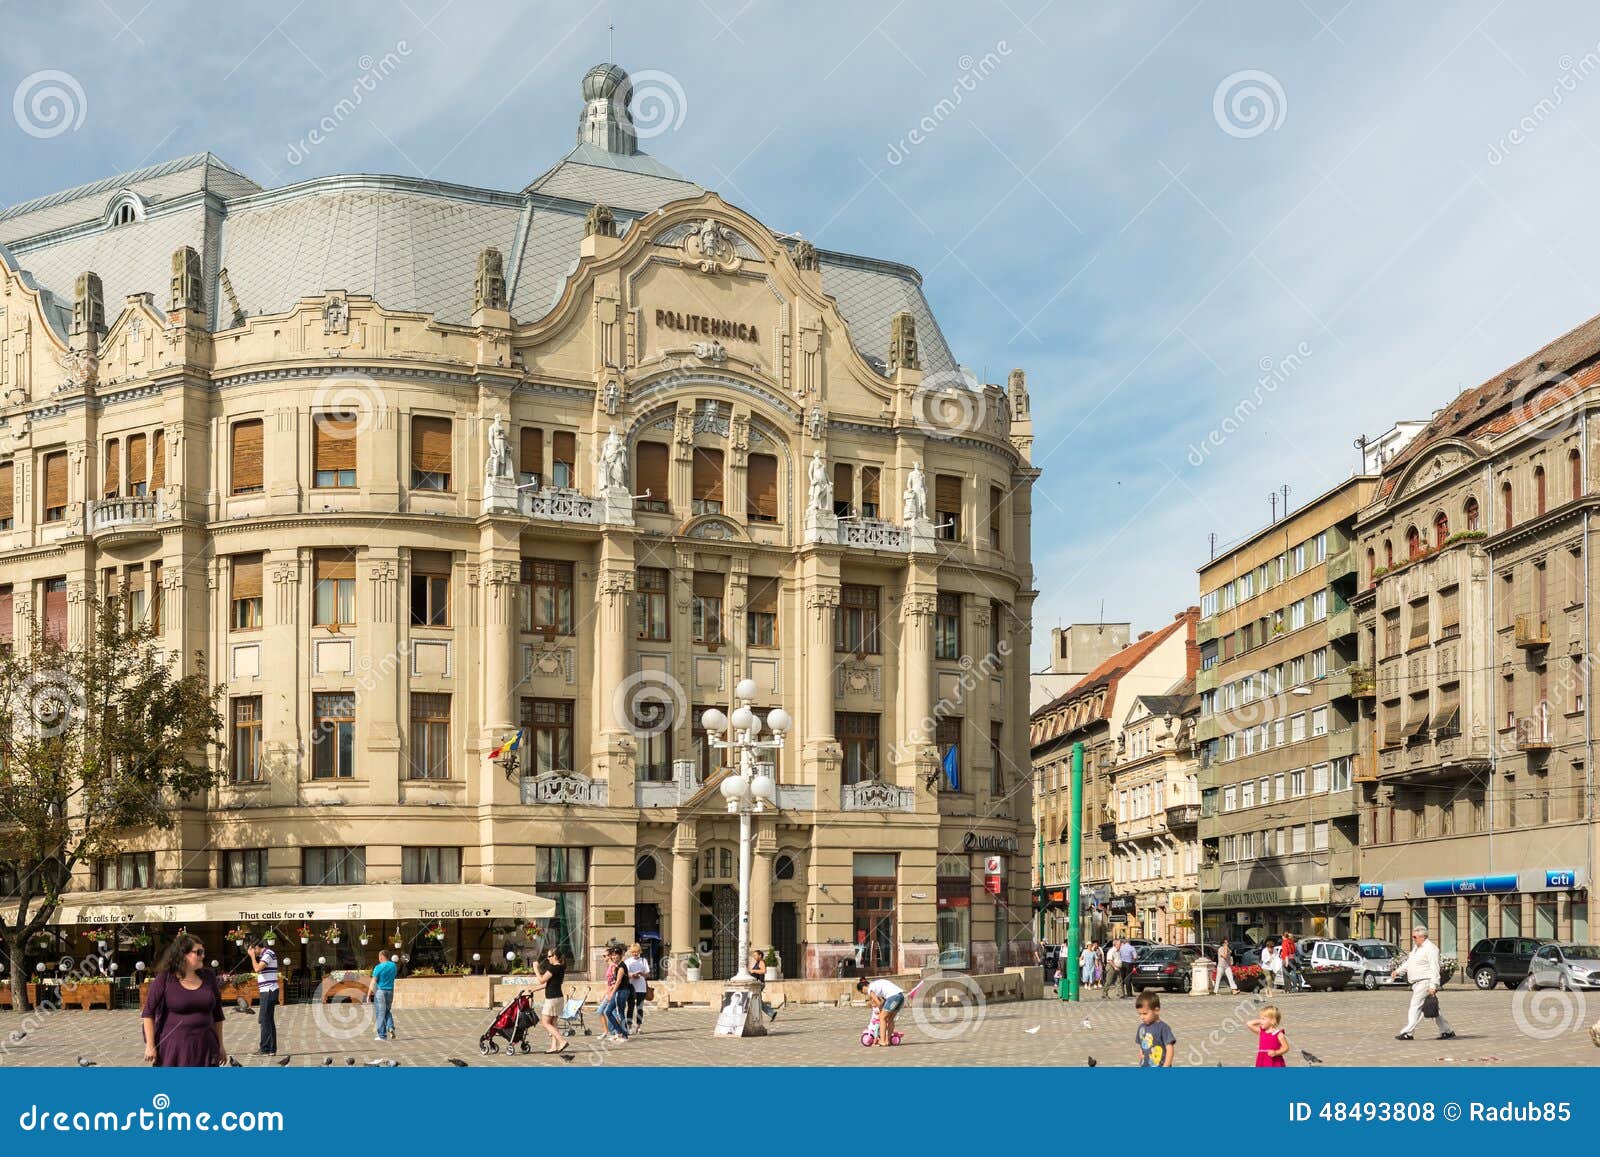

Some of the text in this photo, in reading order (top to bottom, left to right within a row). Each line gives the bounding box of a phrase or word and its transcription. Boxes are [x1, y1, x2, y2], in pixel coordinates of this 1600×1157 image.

[655, 309, 759, 343] POLITEHNICA
[1551, 873, 1569, 885] citi
[1364, 886, 1379, 896] citi
[111, 914, 119, 922] for
[239, 911, 259, 919] That
[262, 911, 281, 919] calls
[284, 911, 295, 919] for
[419, 909, 438, 918] That
[441, 909, 459, 917] calls
[462, 909, 473, 917] for
